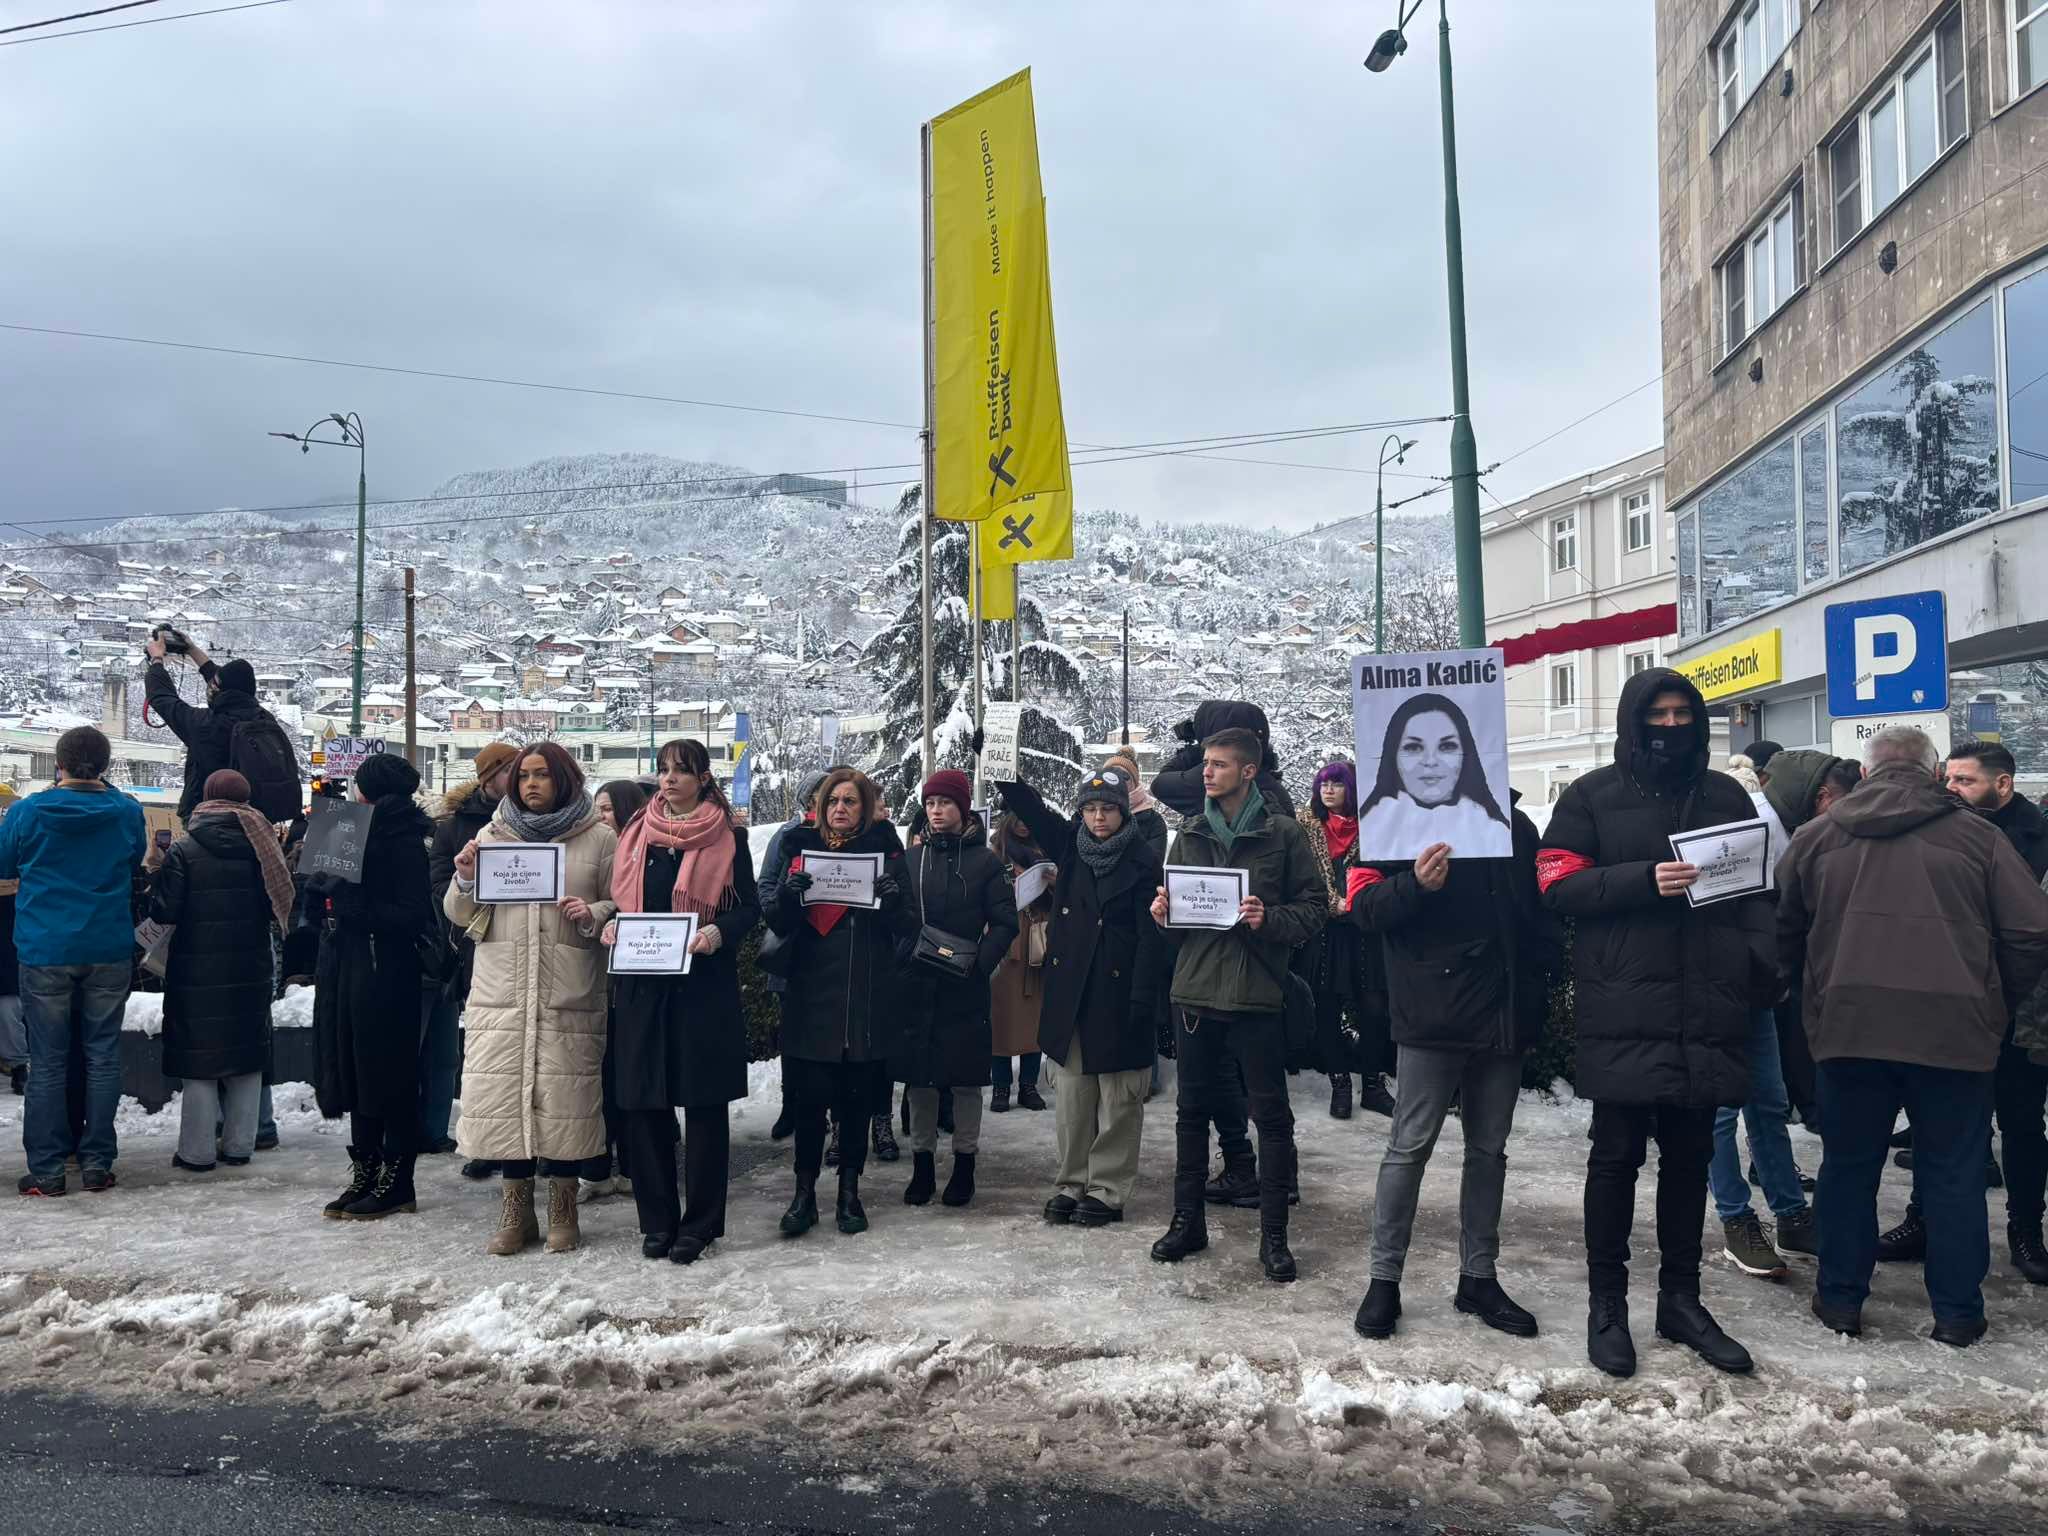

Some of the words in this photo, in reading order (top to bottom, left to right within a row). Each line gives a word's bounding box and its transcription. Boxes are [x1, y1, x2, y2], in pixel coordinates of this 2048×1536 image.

[980, 130, 995, 202] happen
[987, 206, 997, 220] it
[990, 224, 1001, 275] Make
[987, 309, 1000, 440] Raiffeisen
[1731, 647, 1759, 680] Bank
[1854, 613, 1917, 700] P
[1360, 665, 1421, 690] Alma
[1426, 658, 1497, 687] Kadić
[355, 739, 385, 754] SMO
[983, 766, 1015, 780] PRAVDU
[1182, 895, 1197, 903] Koja
[1207, 896, 1228, 904] cijena
